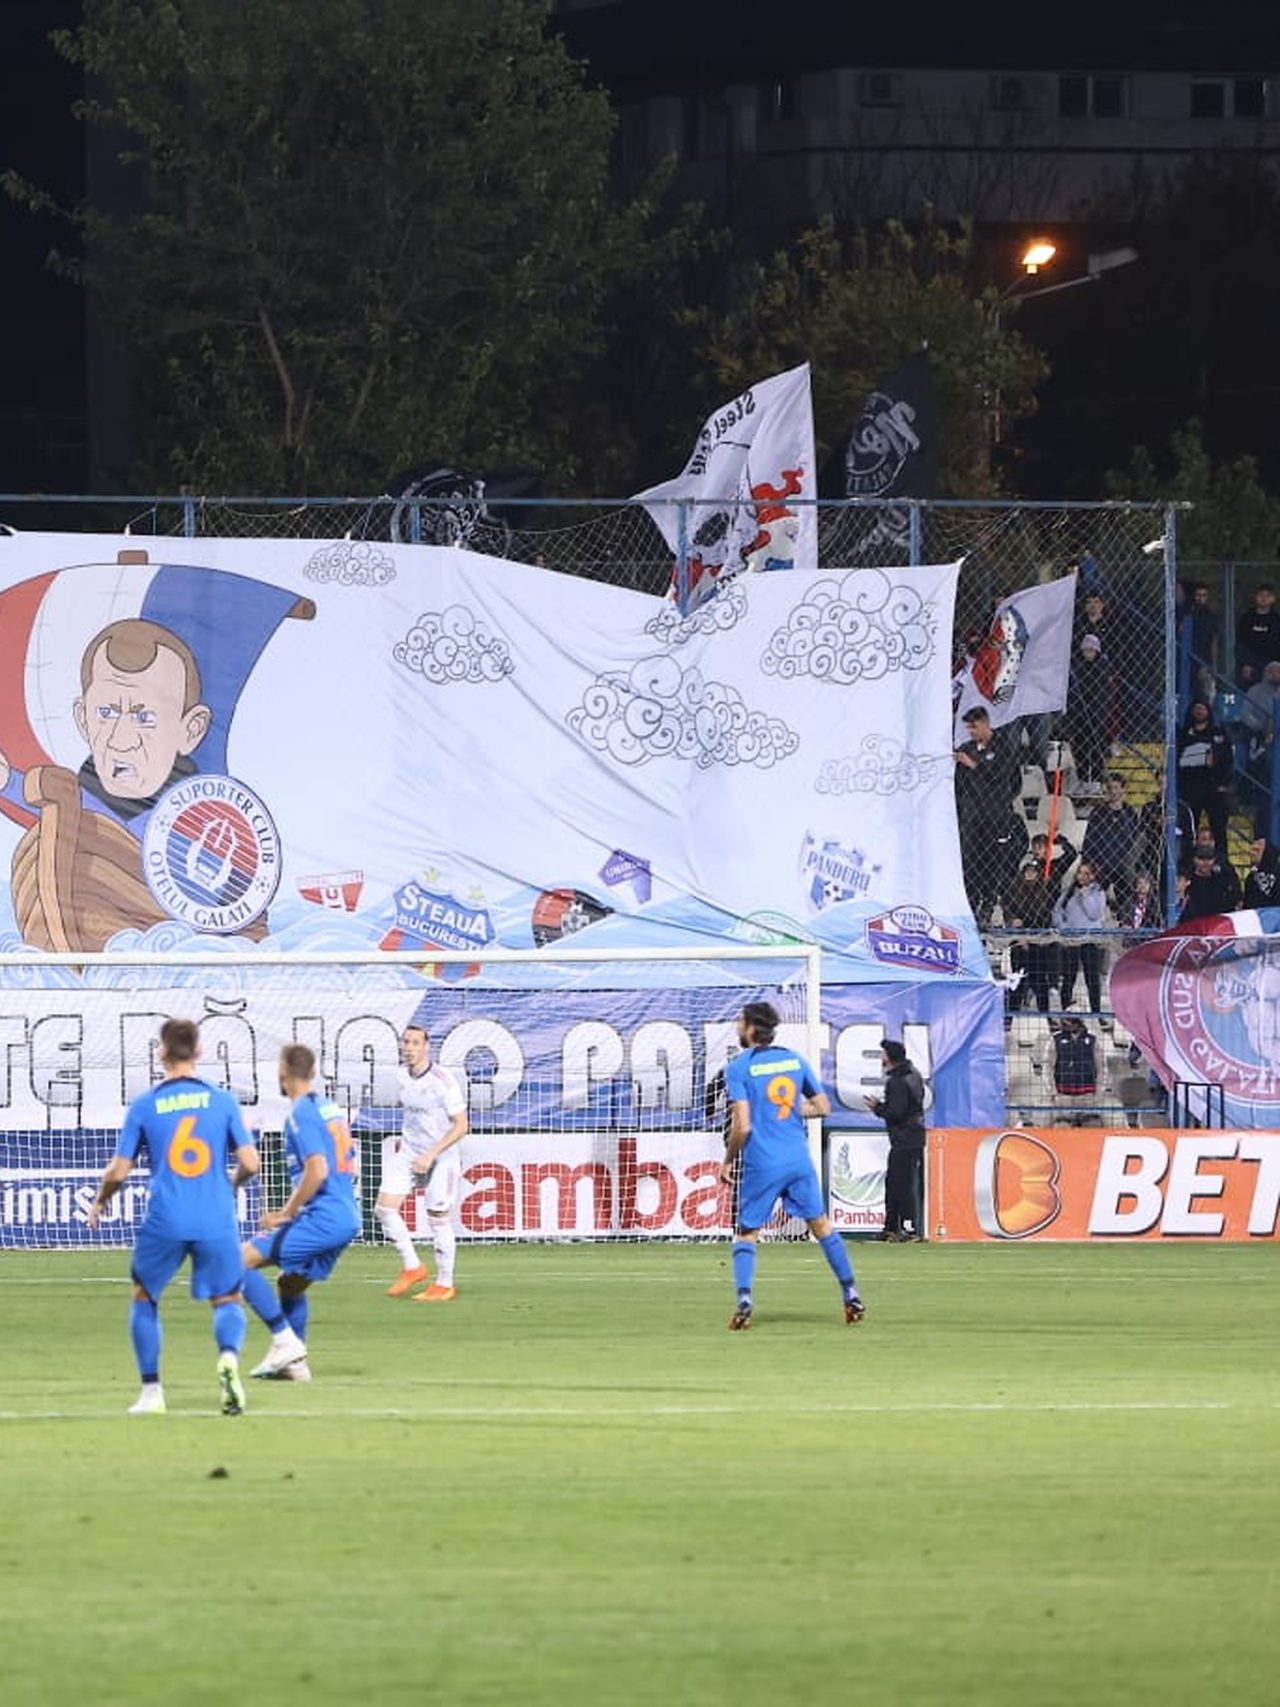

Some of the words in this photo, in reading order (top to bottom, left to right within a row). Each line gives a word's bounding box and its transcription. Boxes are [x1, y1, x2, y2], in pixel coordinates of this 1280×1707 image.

[170, 781, 254, 815] SUPORTER
[251, 815, 275, 864] CLUB
[401, 884, 489, 941] STEAUA
[766, 1075, 797, 1121] 9
[168, 1116, 212, 1178] 6
